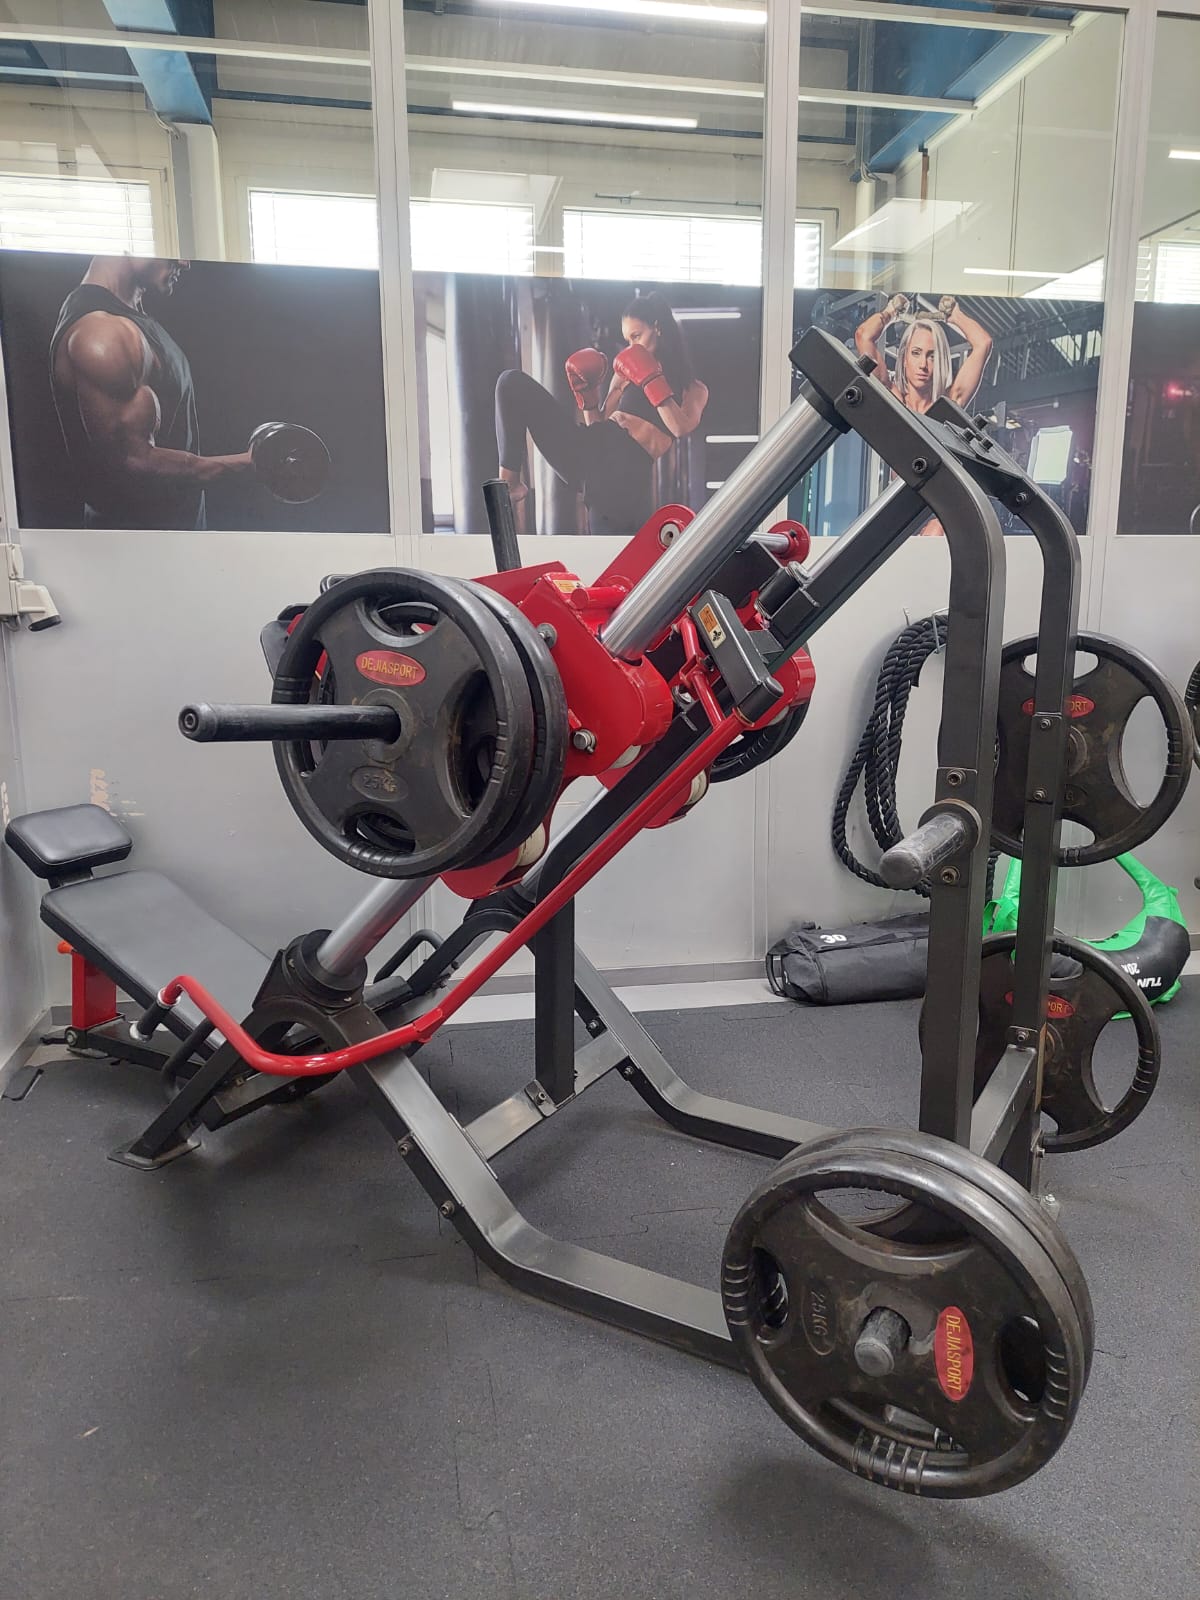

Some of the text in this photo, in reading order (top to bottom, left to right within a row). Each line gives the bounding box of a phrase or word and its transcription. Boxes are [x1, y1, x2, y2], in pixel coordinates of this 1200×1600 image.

[361, 656, 418, 679] DEJIASPORT
[810, 1290, 828, 1336] 25KG
[946, 1314, 961, 1392] DEJIASPORT
